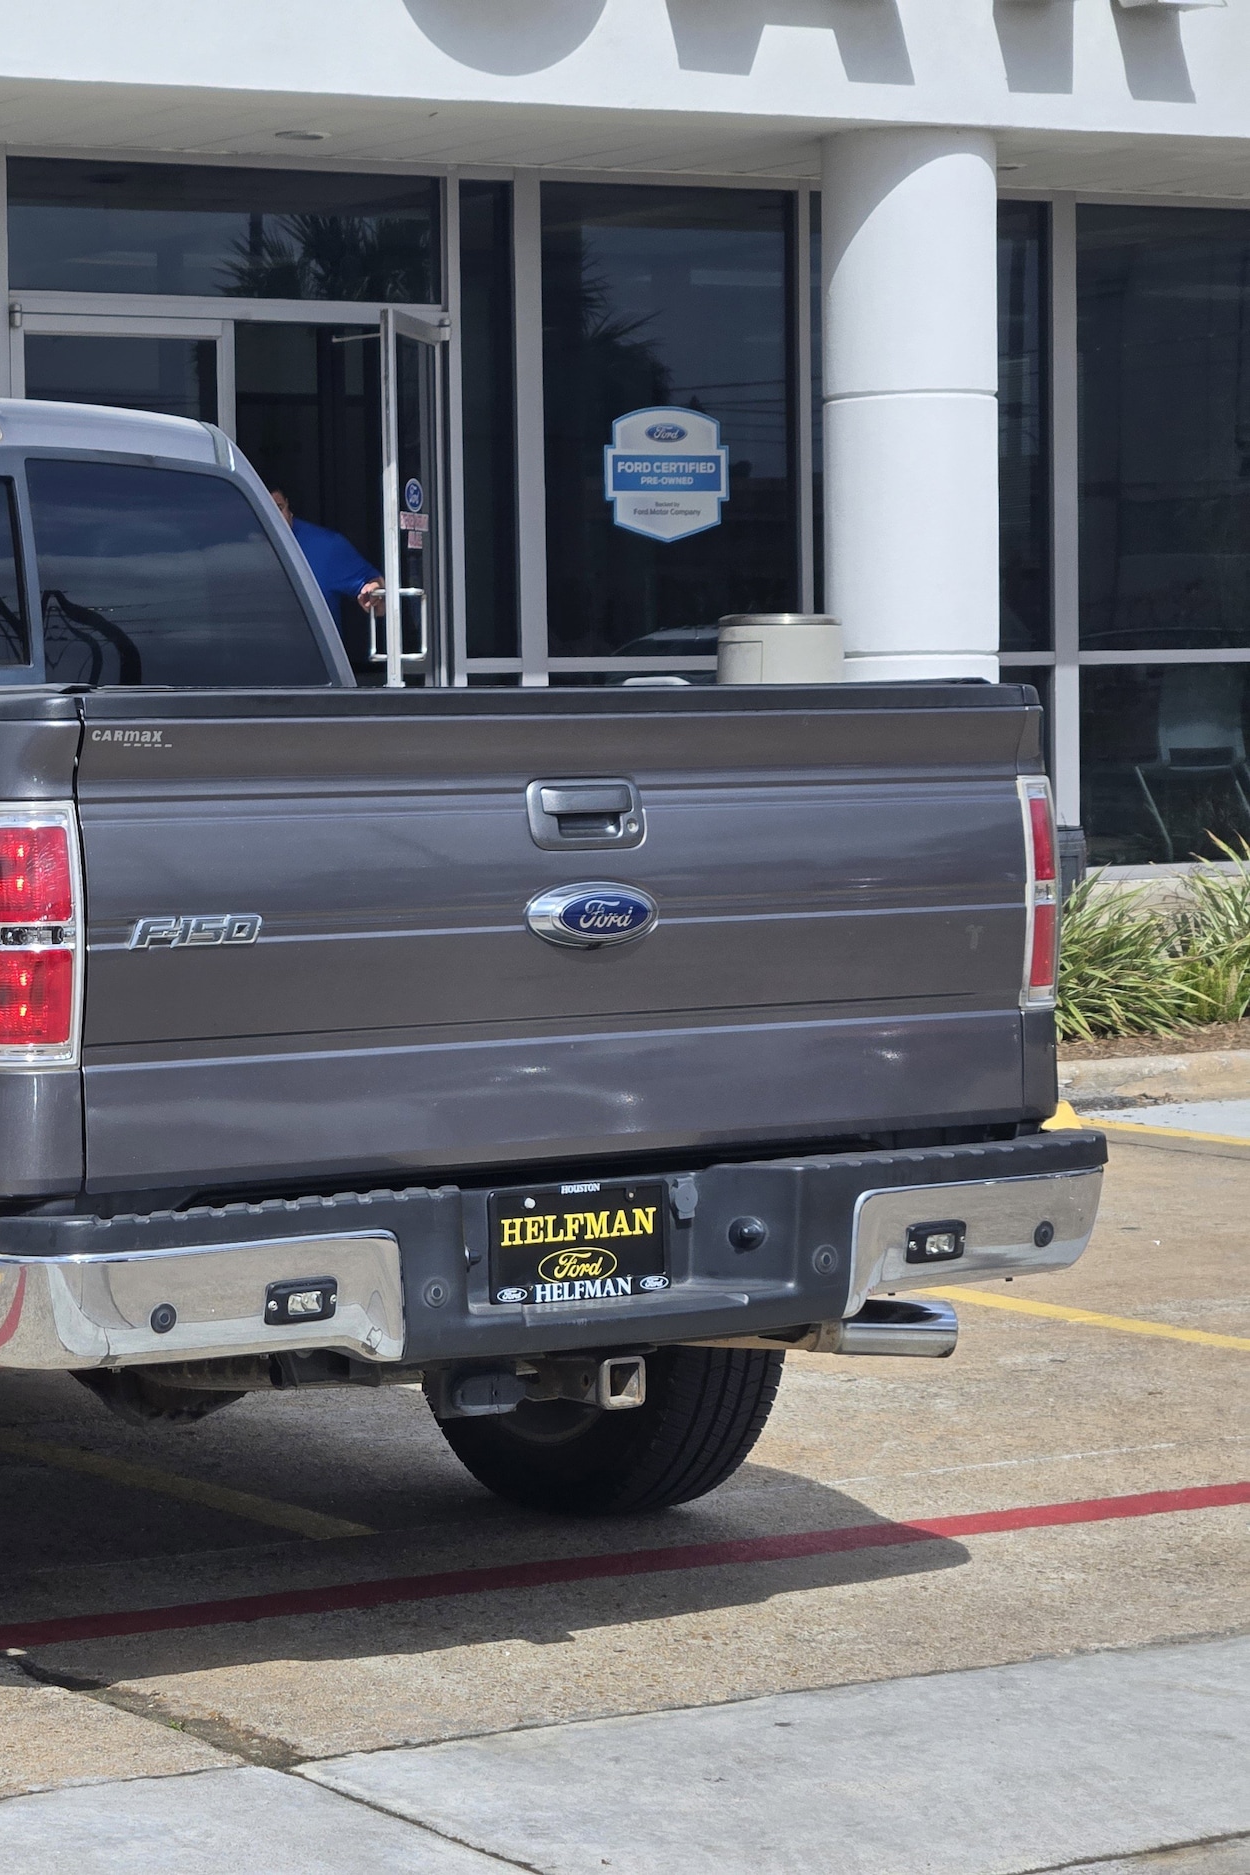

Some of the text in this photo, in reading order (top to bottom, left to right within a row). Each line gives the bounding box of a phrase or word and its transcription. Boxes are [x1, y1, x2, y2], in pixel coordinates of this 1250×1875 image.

[653, 425, 679, 439] Ford
[617, 461, 716, 474] FORD CERTIFIED
[640, 476, 694, 485] PRE-OWNED
[633, 508, 702, 517] Ford Motor Company
[579, 899, 634, 929] Ford
[128, 913, 263, 950] F-150
[560, 1183, 600, 1195] HOUSTON
[500, 1207, 657, 1247] HELFMAN
[553, 1252, 604, 1279] Ford
[501, 1276, 665, 1304] Ford HELFMAN Ford
